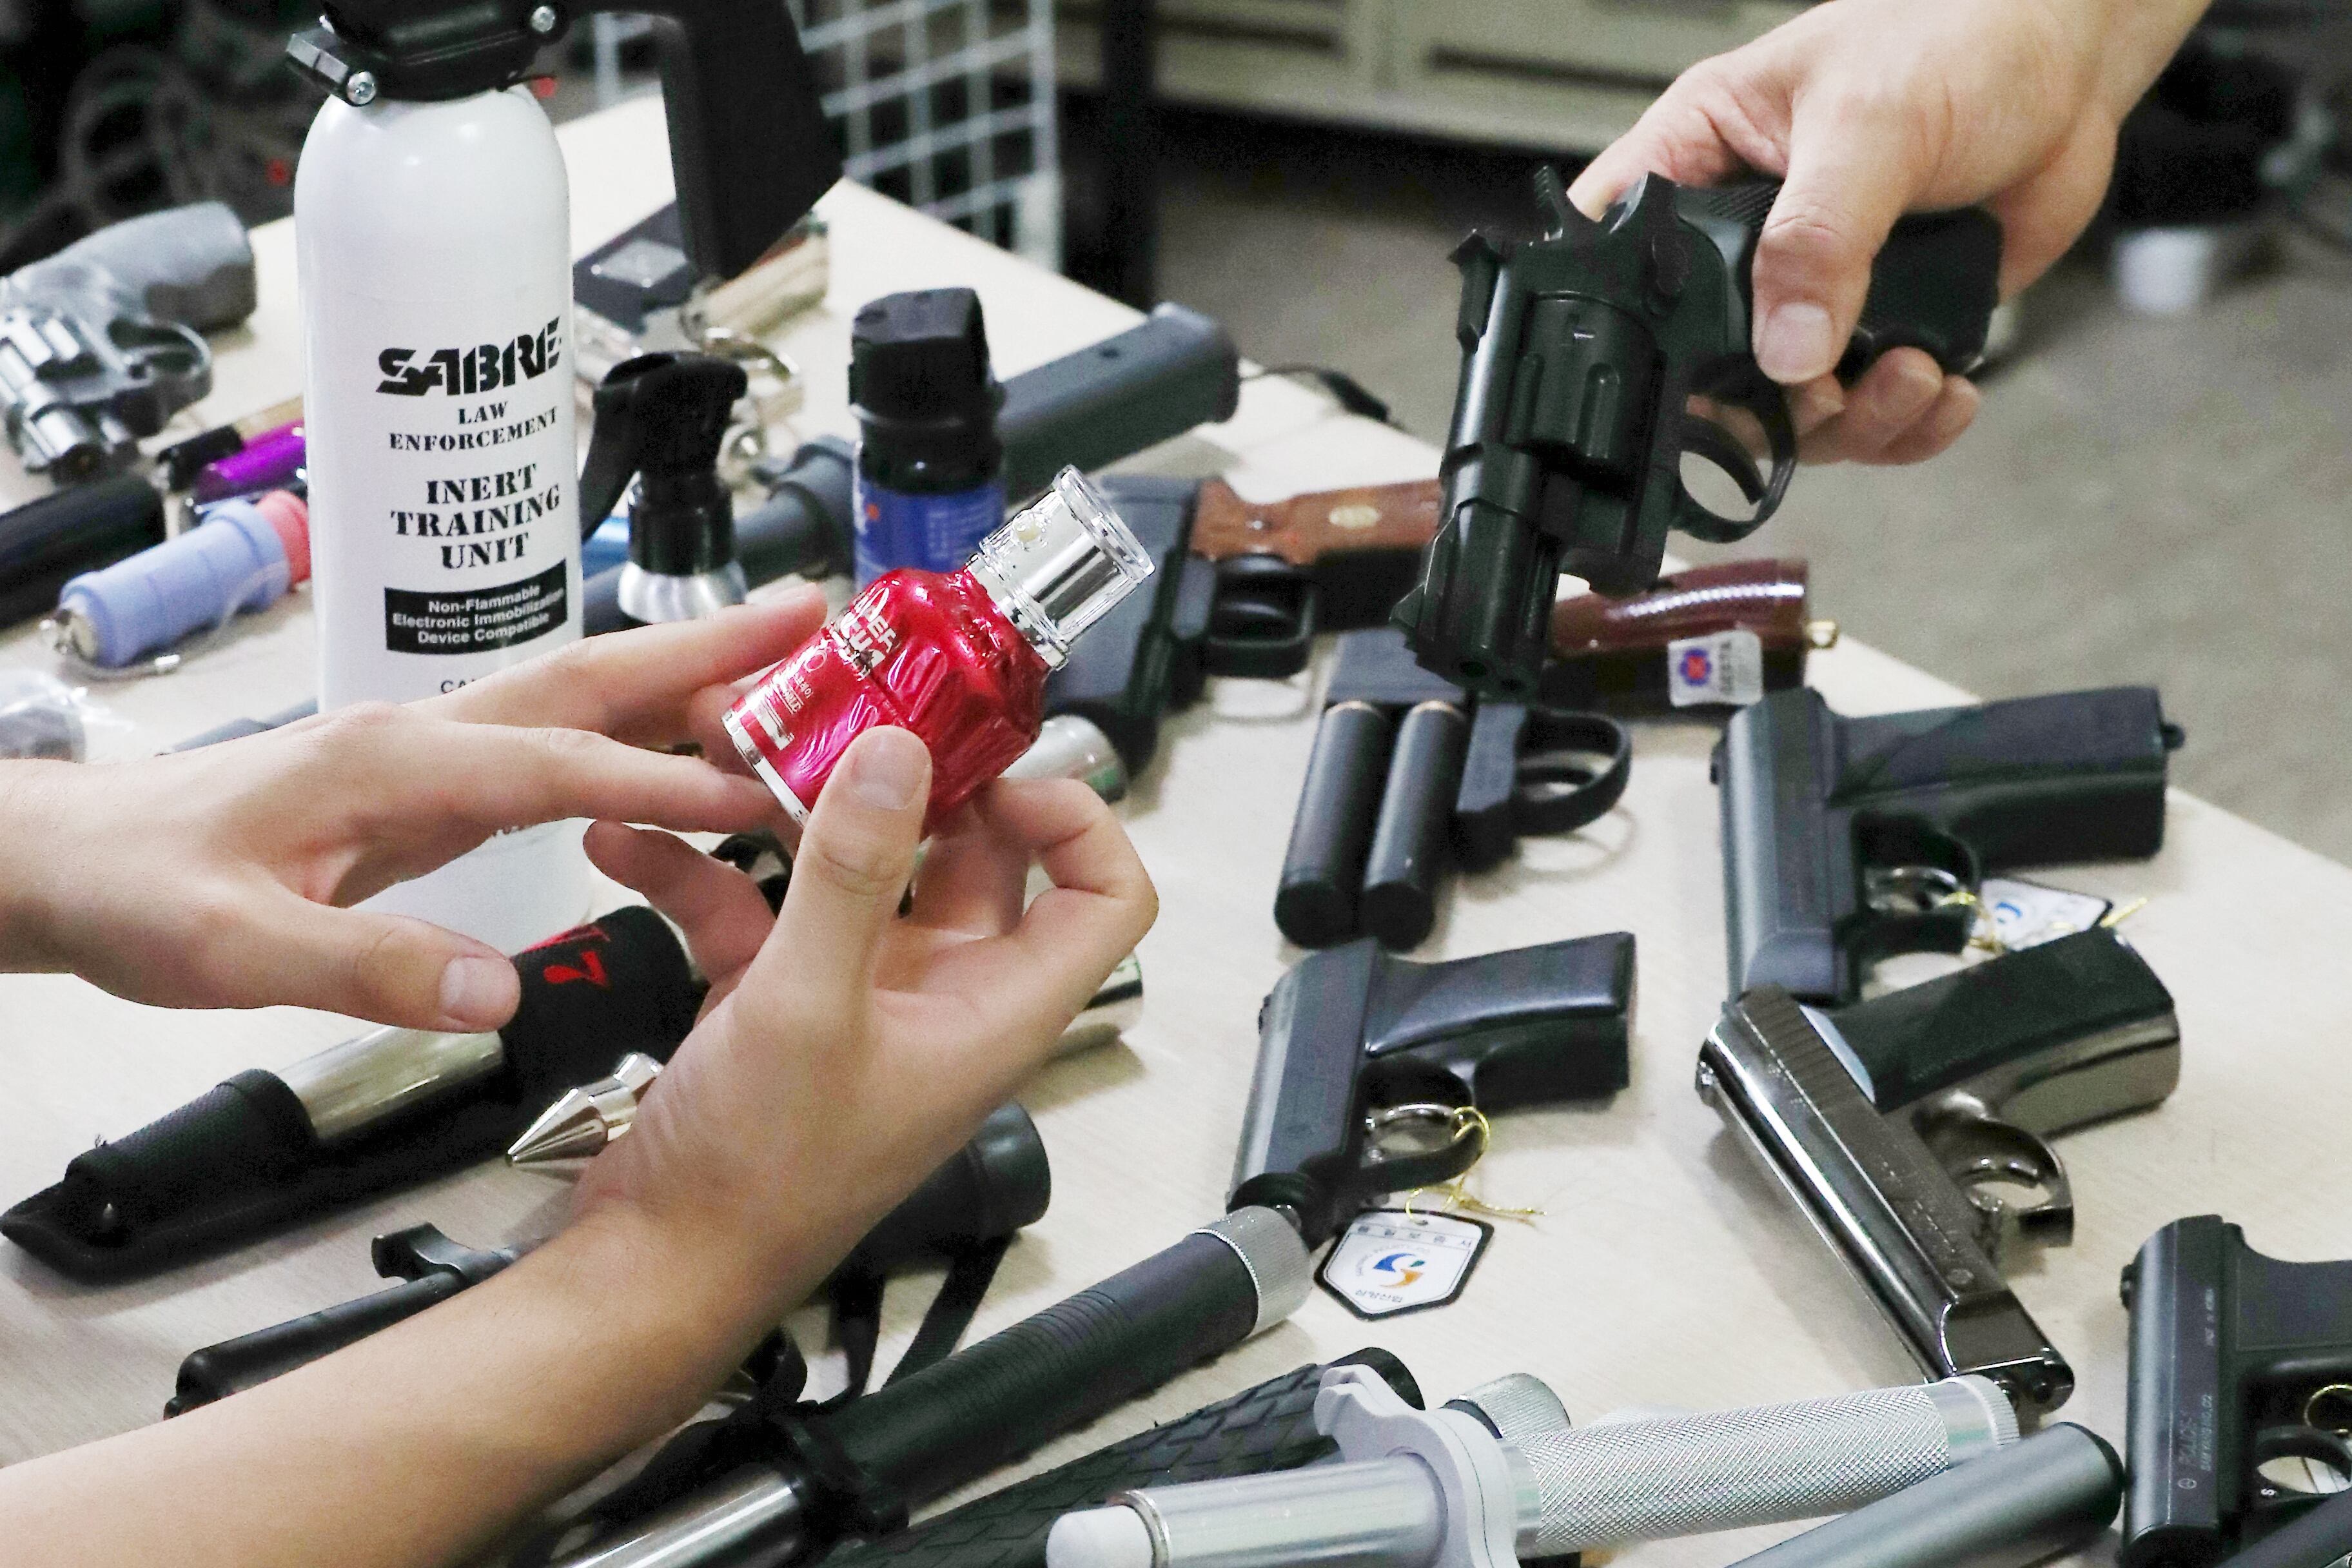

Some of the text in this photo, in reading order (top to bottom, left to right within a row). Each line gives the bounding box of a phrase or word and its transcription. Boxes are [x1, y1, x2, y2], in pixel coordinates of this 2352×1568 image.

[375, 315, 560, 396] SABRE
[389, 406, 558, 451] ENFORCEMENT
[458, 401, 508, 424] LAW
[426, 463, 536, 504] INERT
[391, 484, 559, 536] TRAINING
[441, 532, 529, 569] UNIT
[428, 585, 540, 613] Non-Flammable
[392, 612, 469, 629] Electronic
[418, 612, 550, 643] Device Compatible
